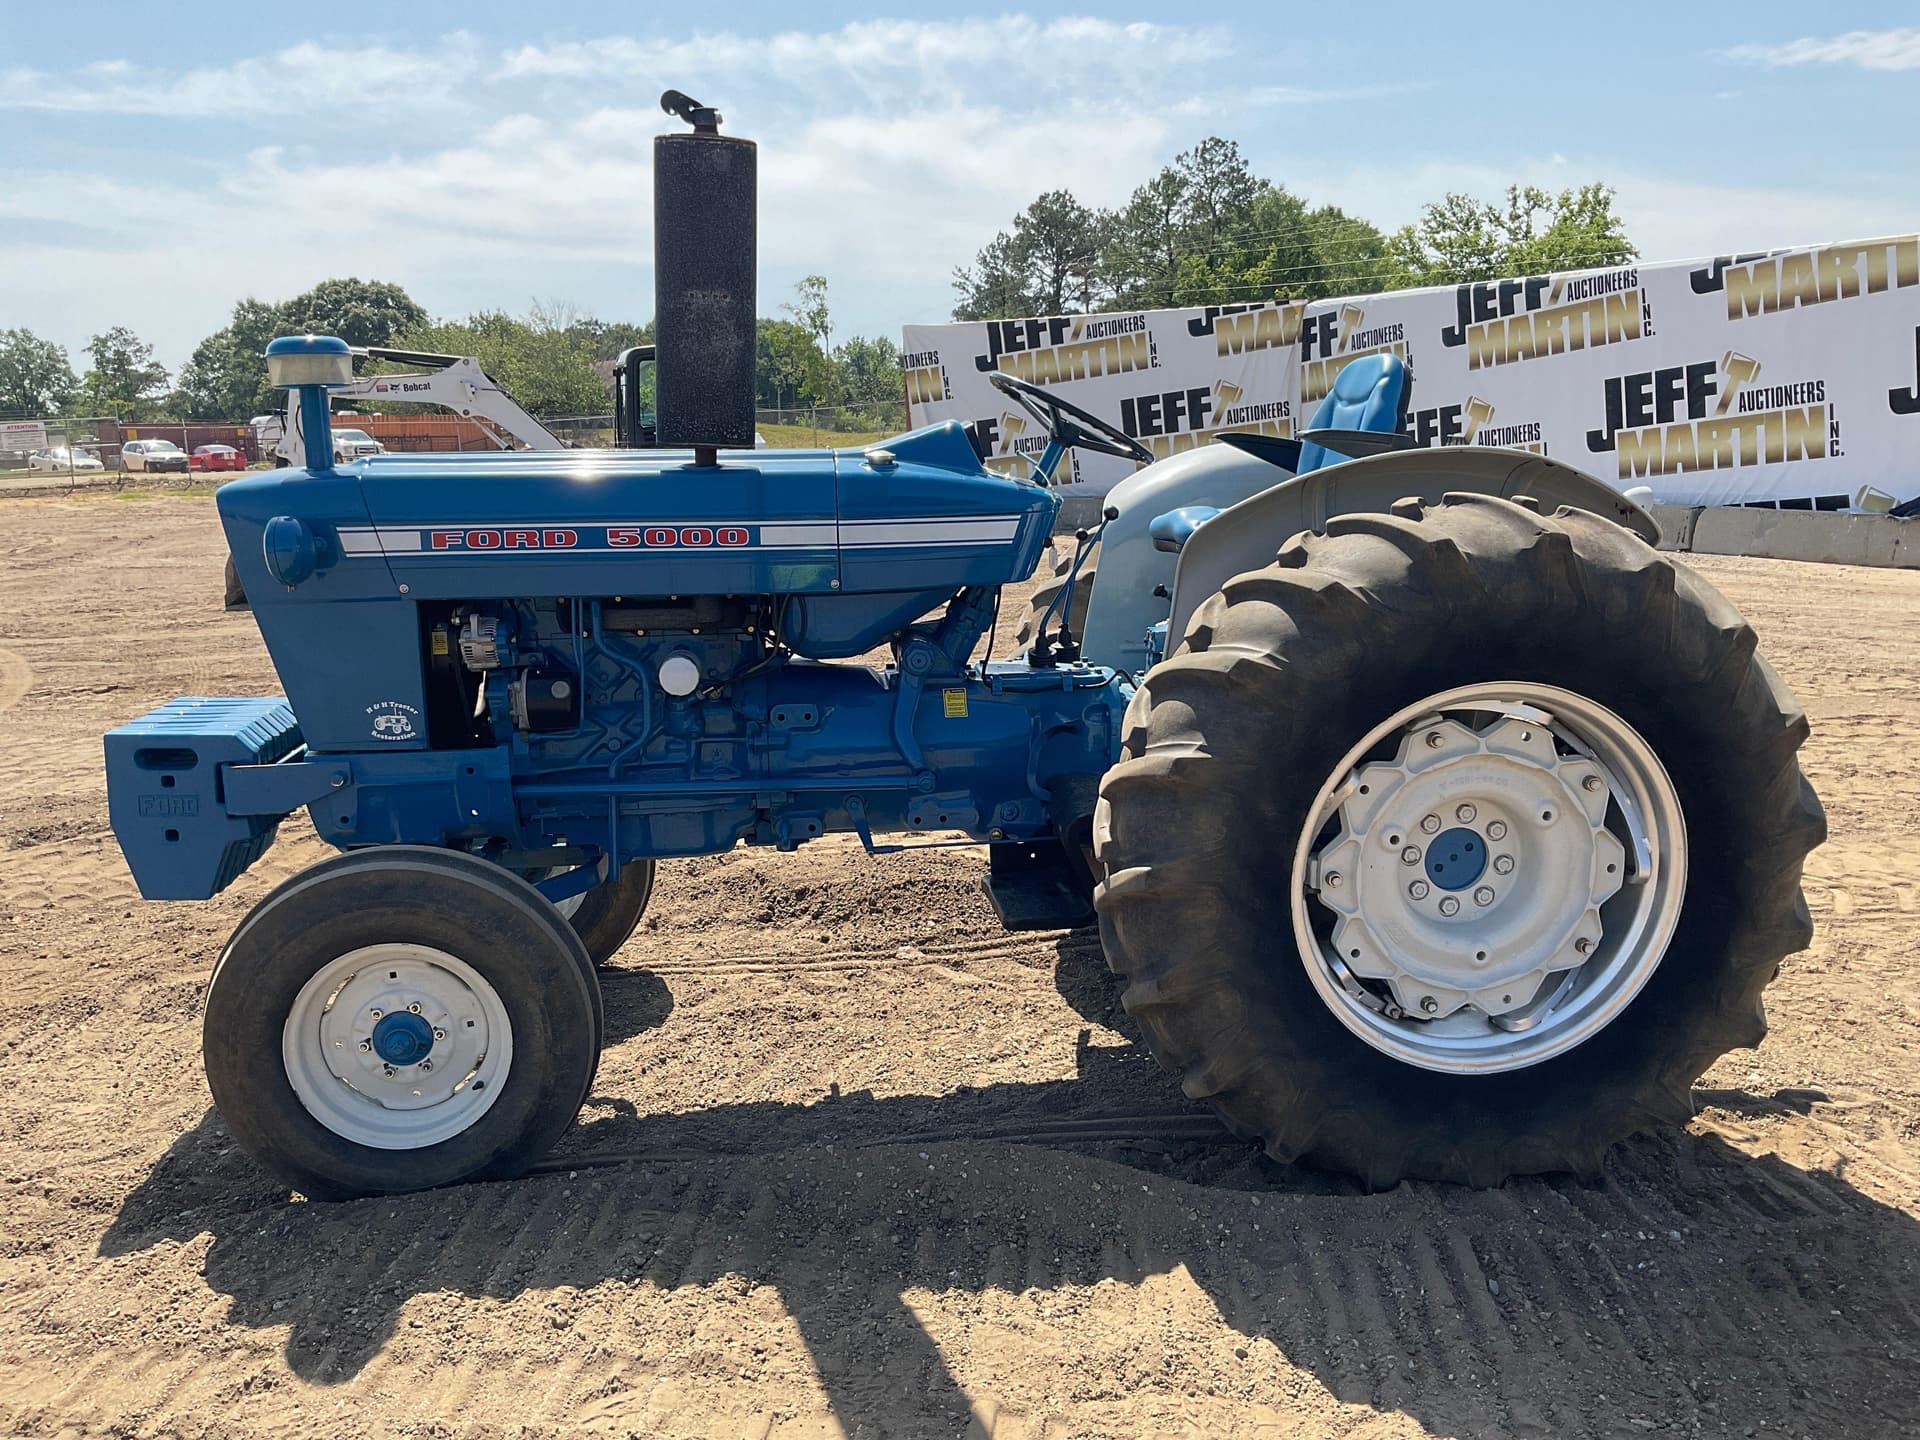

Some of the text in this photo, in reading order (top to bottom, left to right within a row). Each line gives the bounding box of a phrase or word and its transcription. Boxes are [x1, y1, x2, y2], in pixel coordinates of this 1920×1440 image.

[1567, 268, 1638, 302] AUCTIONEERS
[1725, 236, 1919, 321] MARTI
[1086, 315, 1146, 340] AUCTIONEERS
[1442, 277, 1550, 347] JEFF
[975, 318, 1071, 372] JEFF
[1351, 323, 1404, 351] AUCTIONEERS
[1468, 290, 1641, 371] MARTIN
[998, 332, 1149, 386] MARTIN
[403, 382, 431, 393] Bobcat
[1738, 380, 1825, 413] AUCTIONEERS
[1226, 401, 1290, 425] AUCTIONEERS
[1586, 361, 1718, 452] JEFF
[1478, 423, 1541, 446] AUCTIONEERS
[1618, 405, 1826, 480] MARTIN
[431, 527, 750, 550] FORD 5000
[389, 701, 419, 714] Tractor
[371, 730, 416, 741] Restoration
